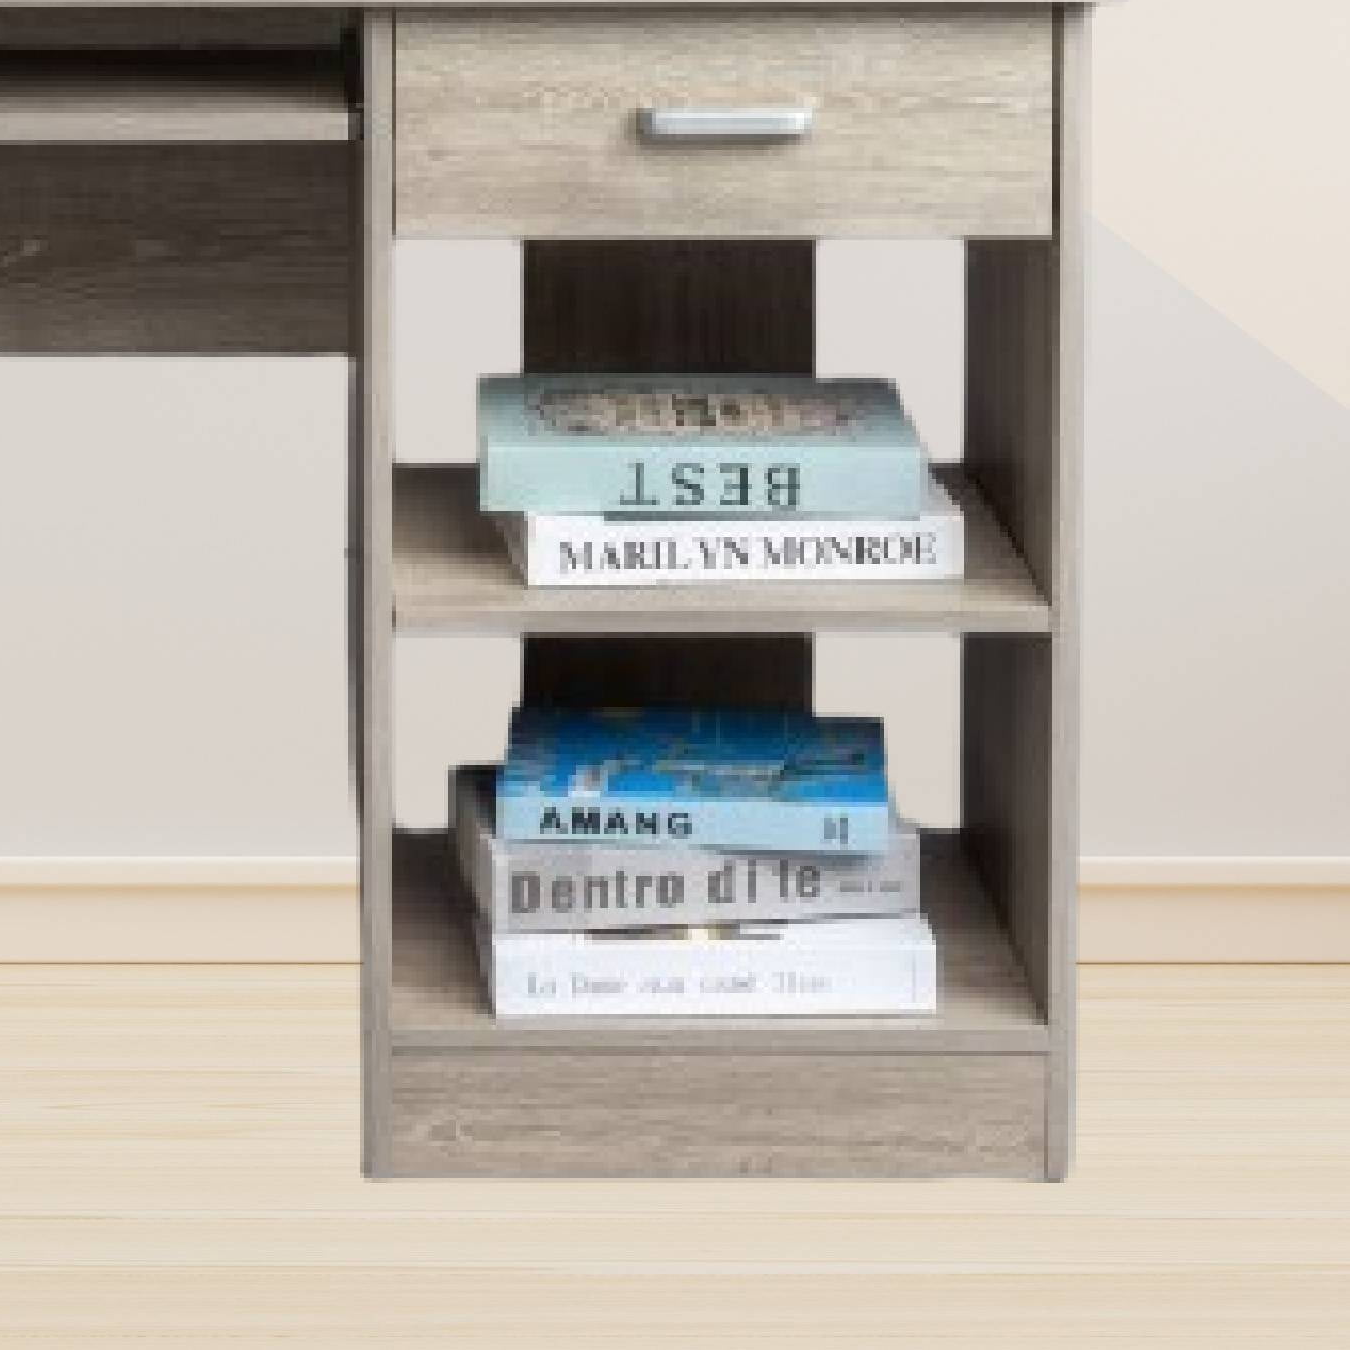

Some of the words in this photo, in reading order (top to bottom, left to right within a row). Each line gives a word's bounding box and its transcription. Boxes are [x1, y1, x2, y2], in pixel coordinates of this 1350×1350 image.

[619, 462, 802, 506] BEST
[559, 537, 749, 570] MARILYN
[763, 533, 937, 566] MONROE
[539, 806, 693, 840] AMANG
[511, 869, 685, 914] Dentro
